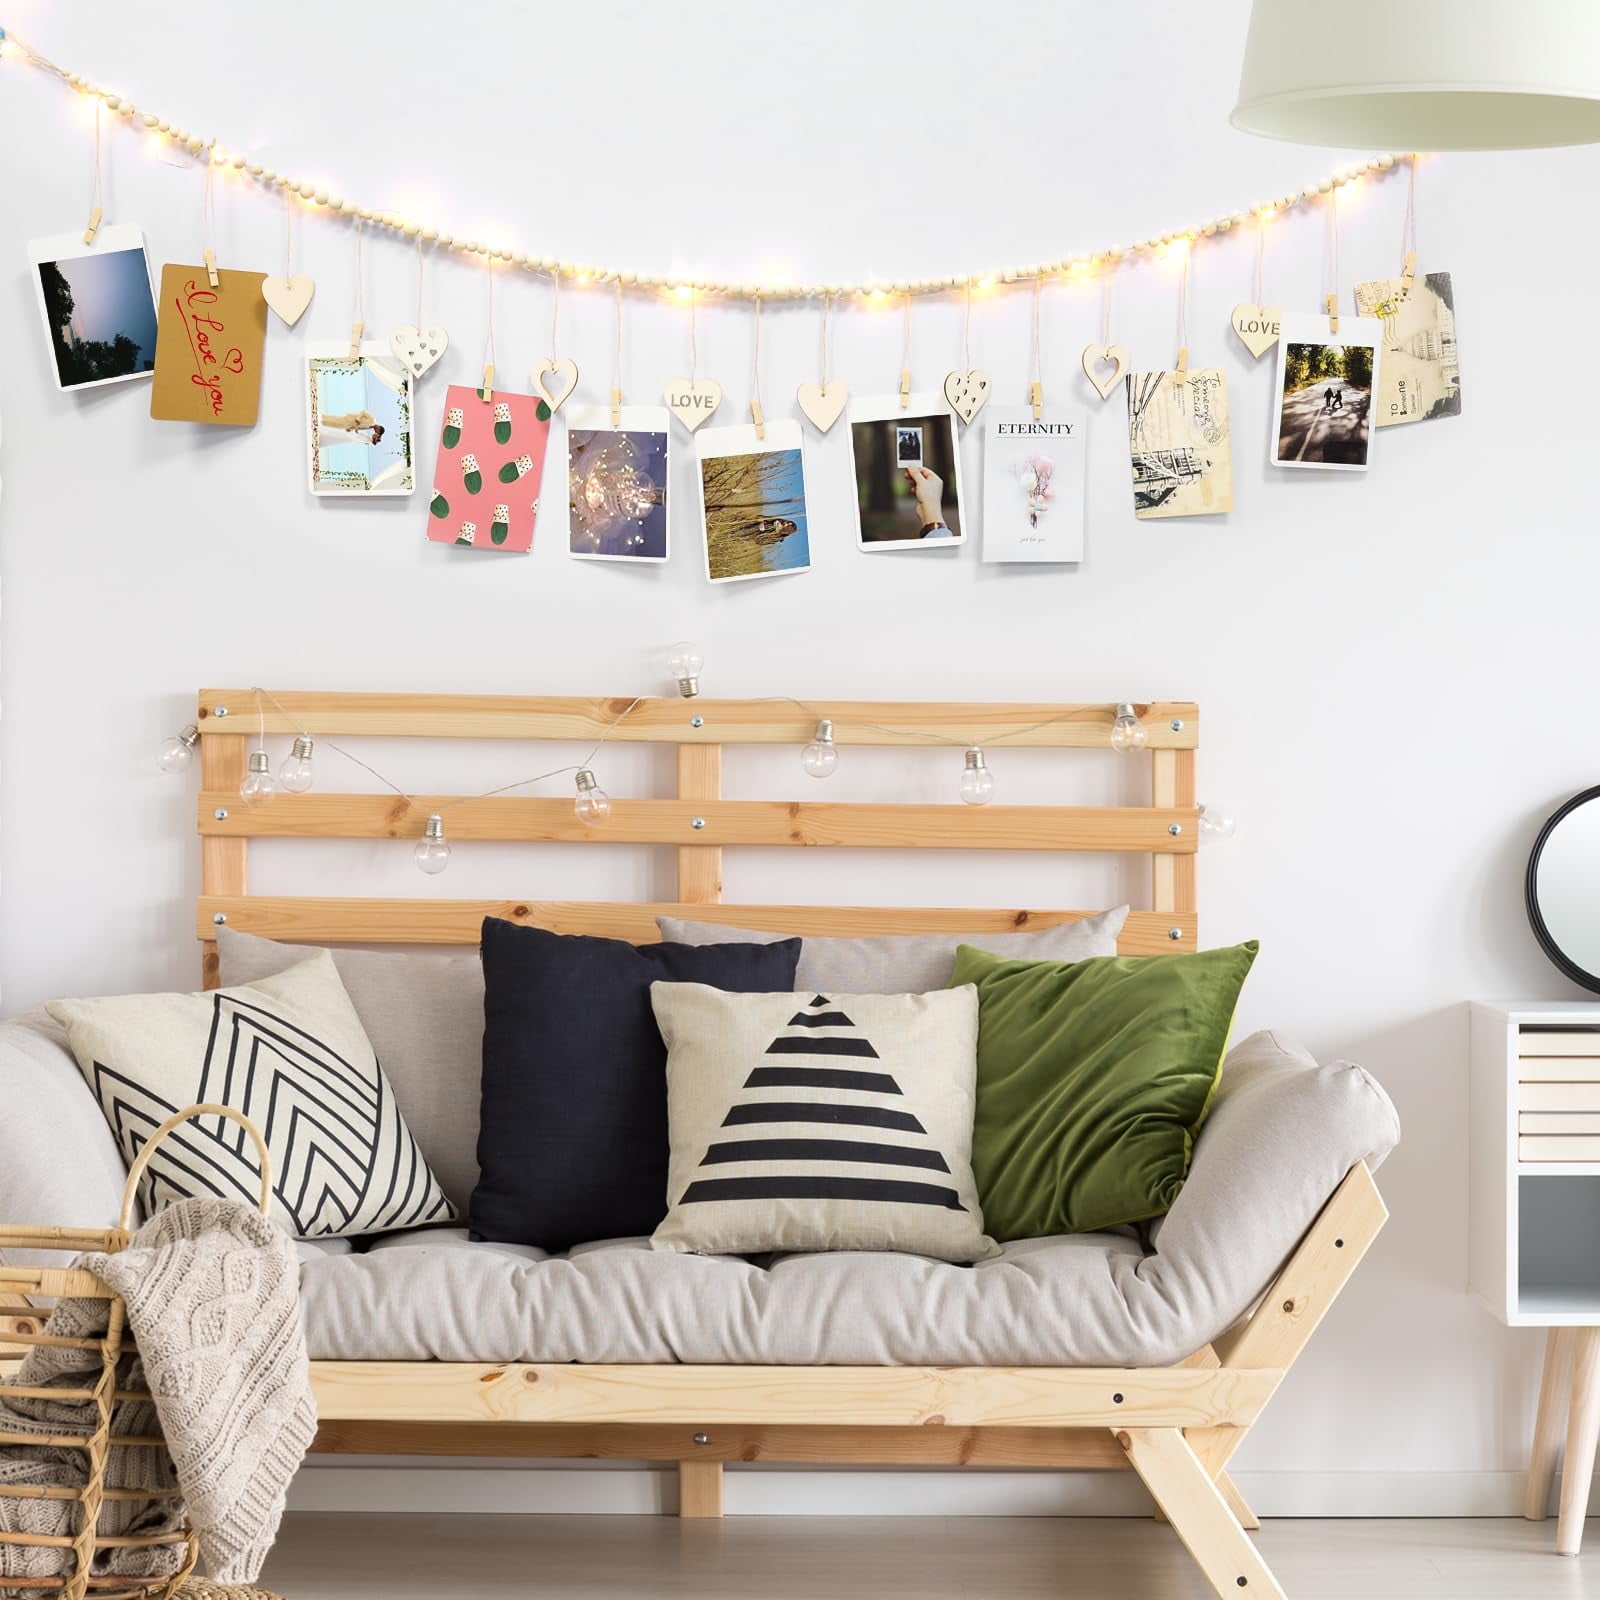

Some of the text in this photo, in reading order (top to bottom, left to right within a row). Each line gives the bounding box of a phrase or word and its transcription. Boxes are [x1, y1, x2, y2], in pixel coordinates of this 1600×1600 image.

[1239, 319, 1280, 336] LOVE
[191, 312, 224, 365] Love
[191, 375, 224, 416] you
[671, 393, 714, 409] LOVE
[998, 423, 1074, 435] ETERNITY
